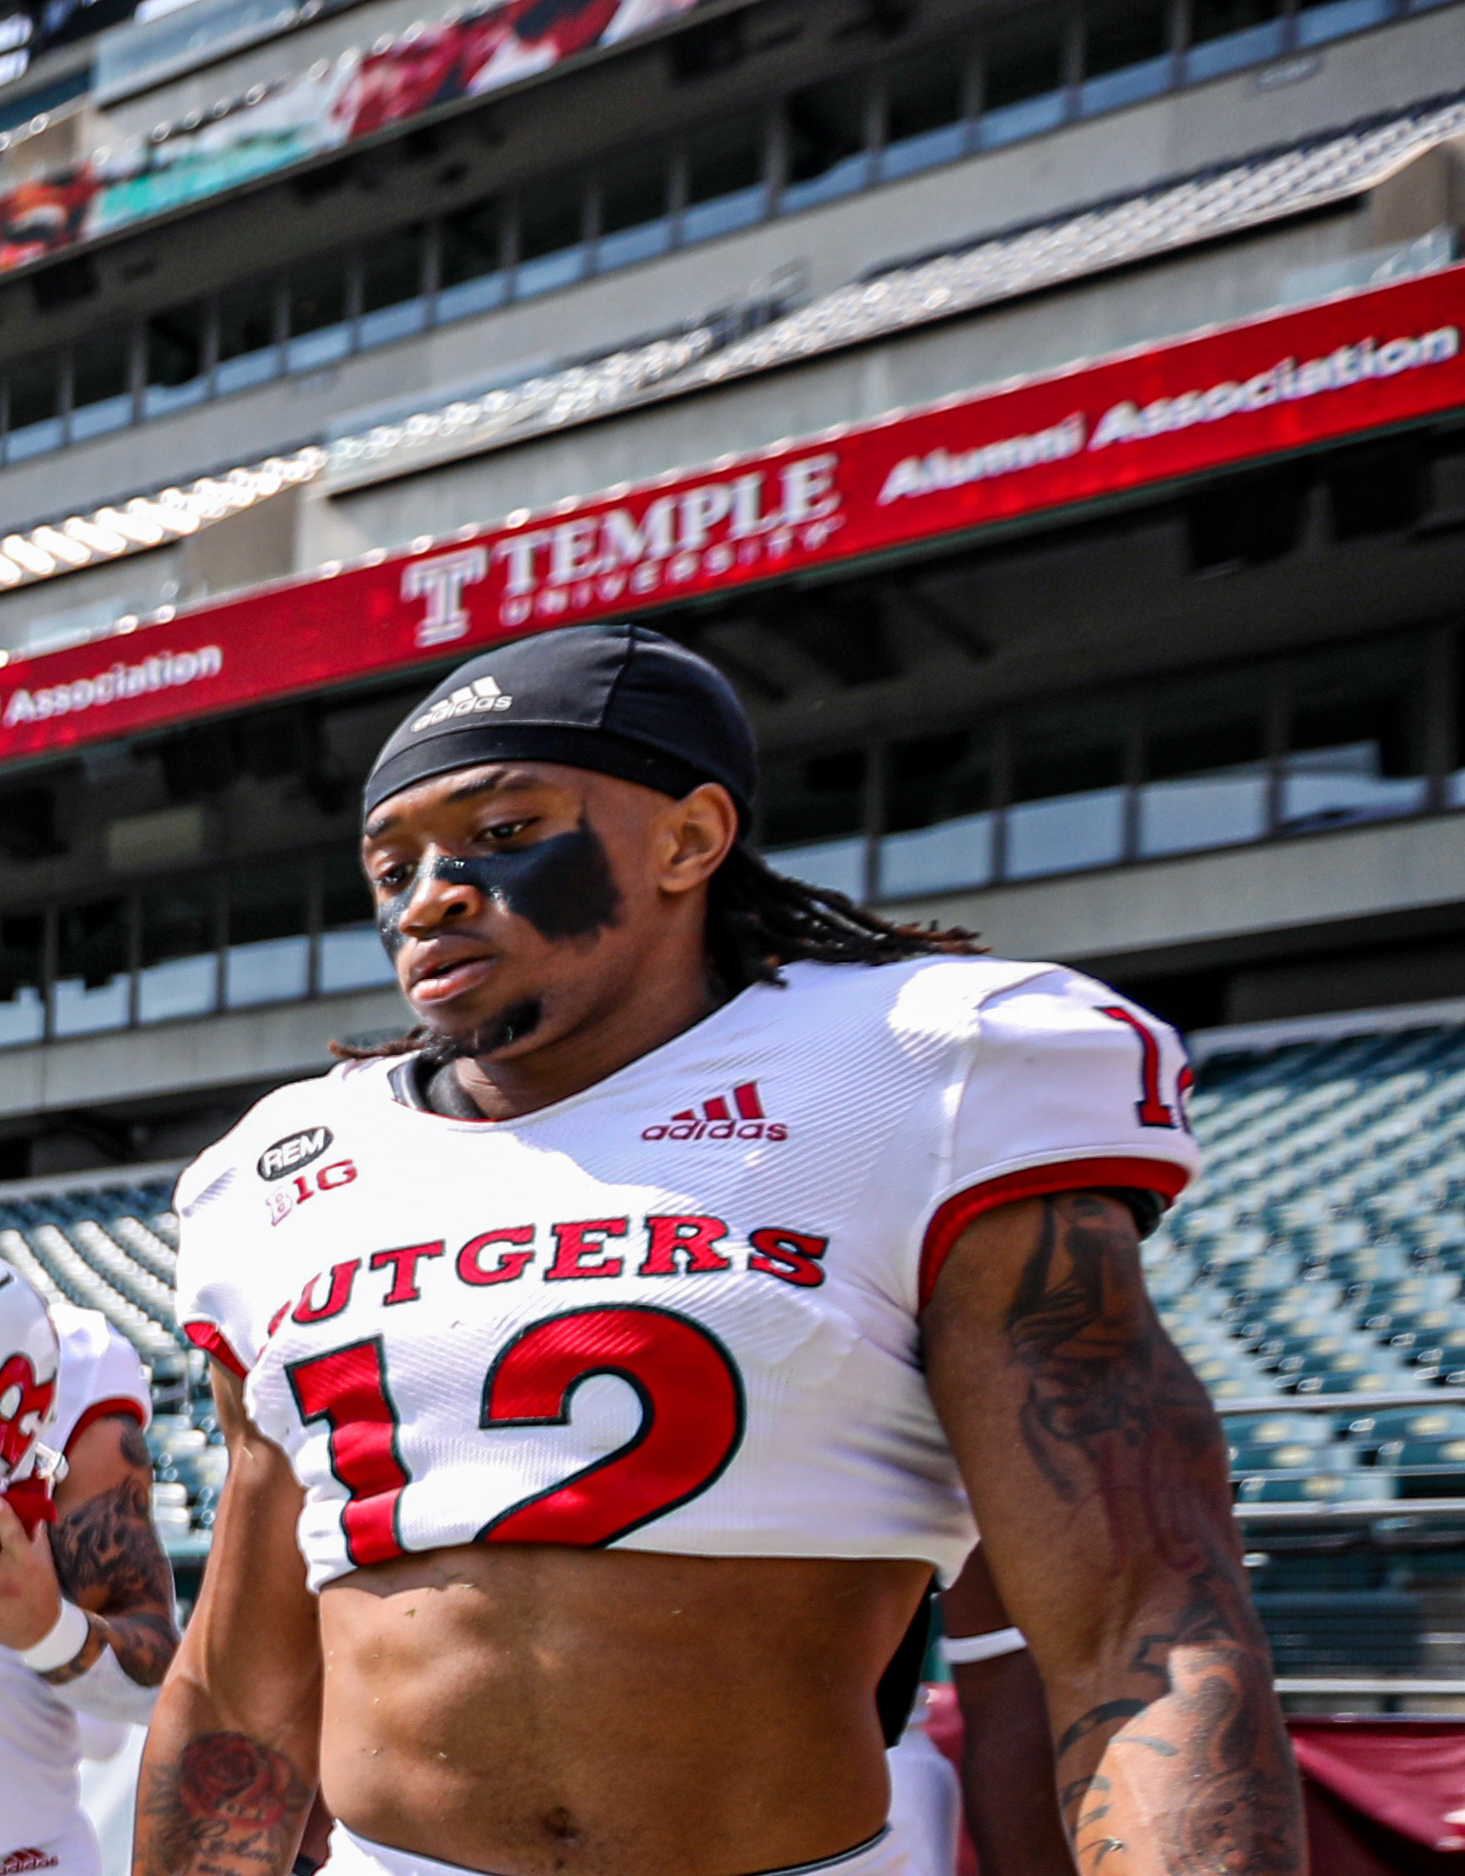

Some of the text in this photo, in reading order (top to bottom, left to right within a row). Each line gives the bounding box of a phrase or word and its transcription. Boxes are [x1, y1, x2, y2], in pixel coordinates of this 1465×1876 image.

[878, 324, 1460, 504] Alumni Association
[500, 452, 842, 594] TEMPLE
[500, 513, 846, 628] UNIVERSITY
[402, 543, 486, 649] T
[5, 644, 223, 728] Association
[410, 692, 514, 734] adidas
[263, 1127, 327, 1177] REM
[640, 1113, 789, 1143] adidas
[282, 1301, 747, 1567] 12
